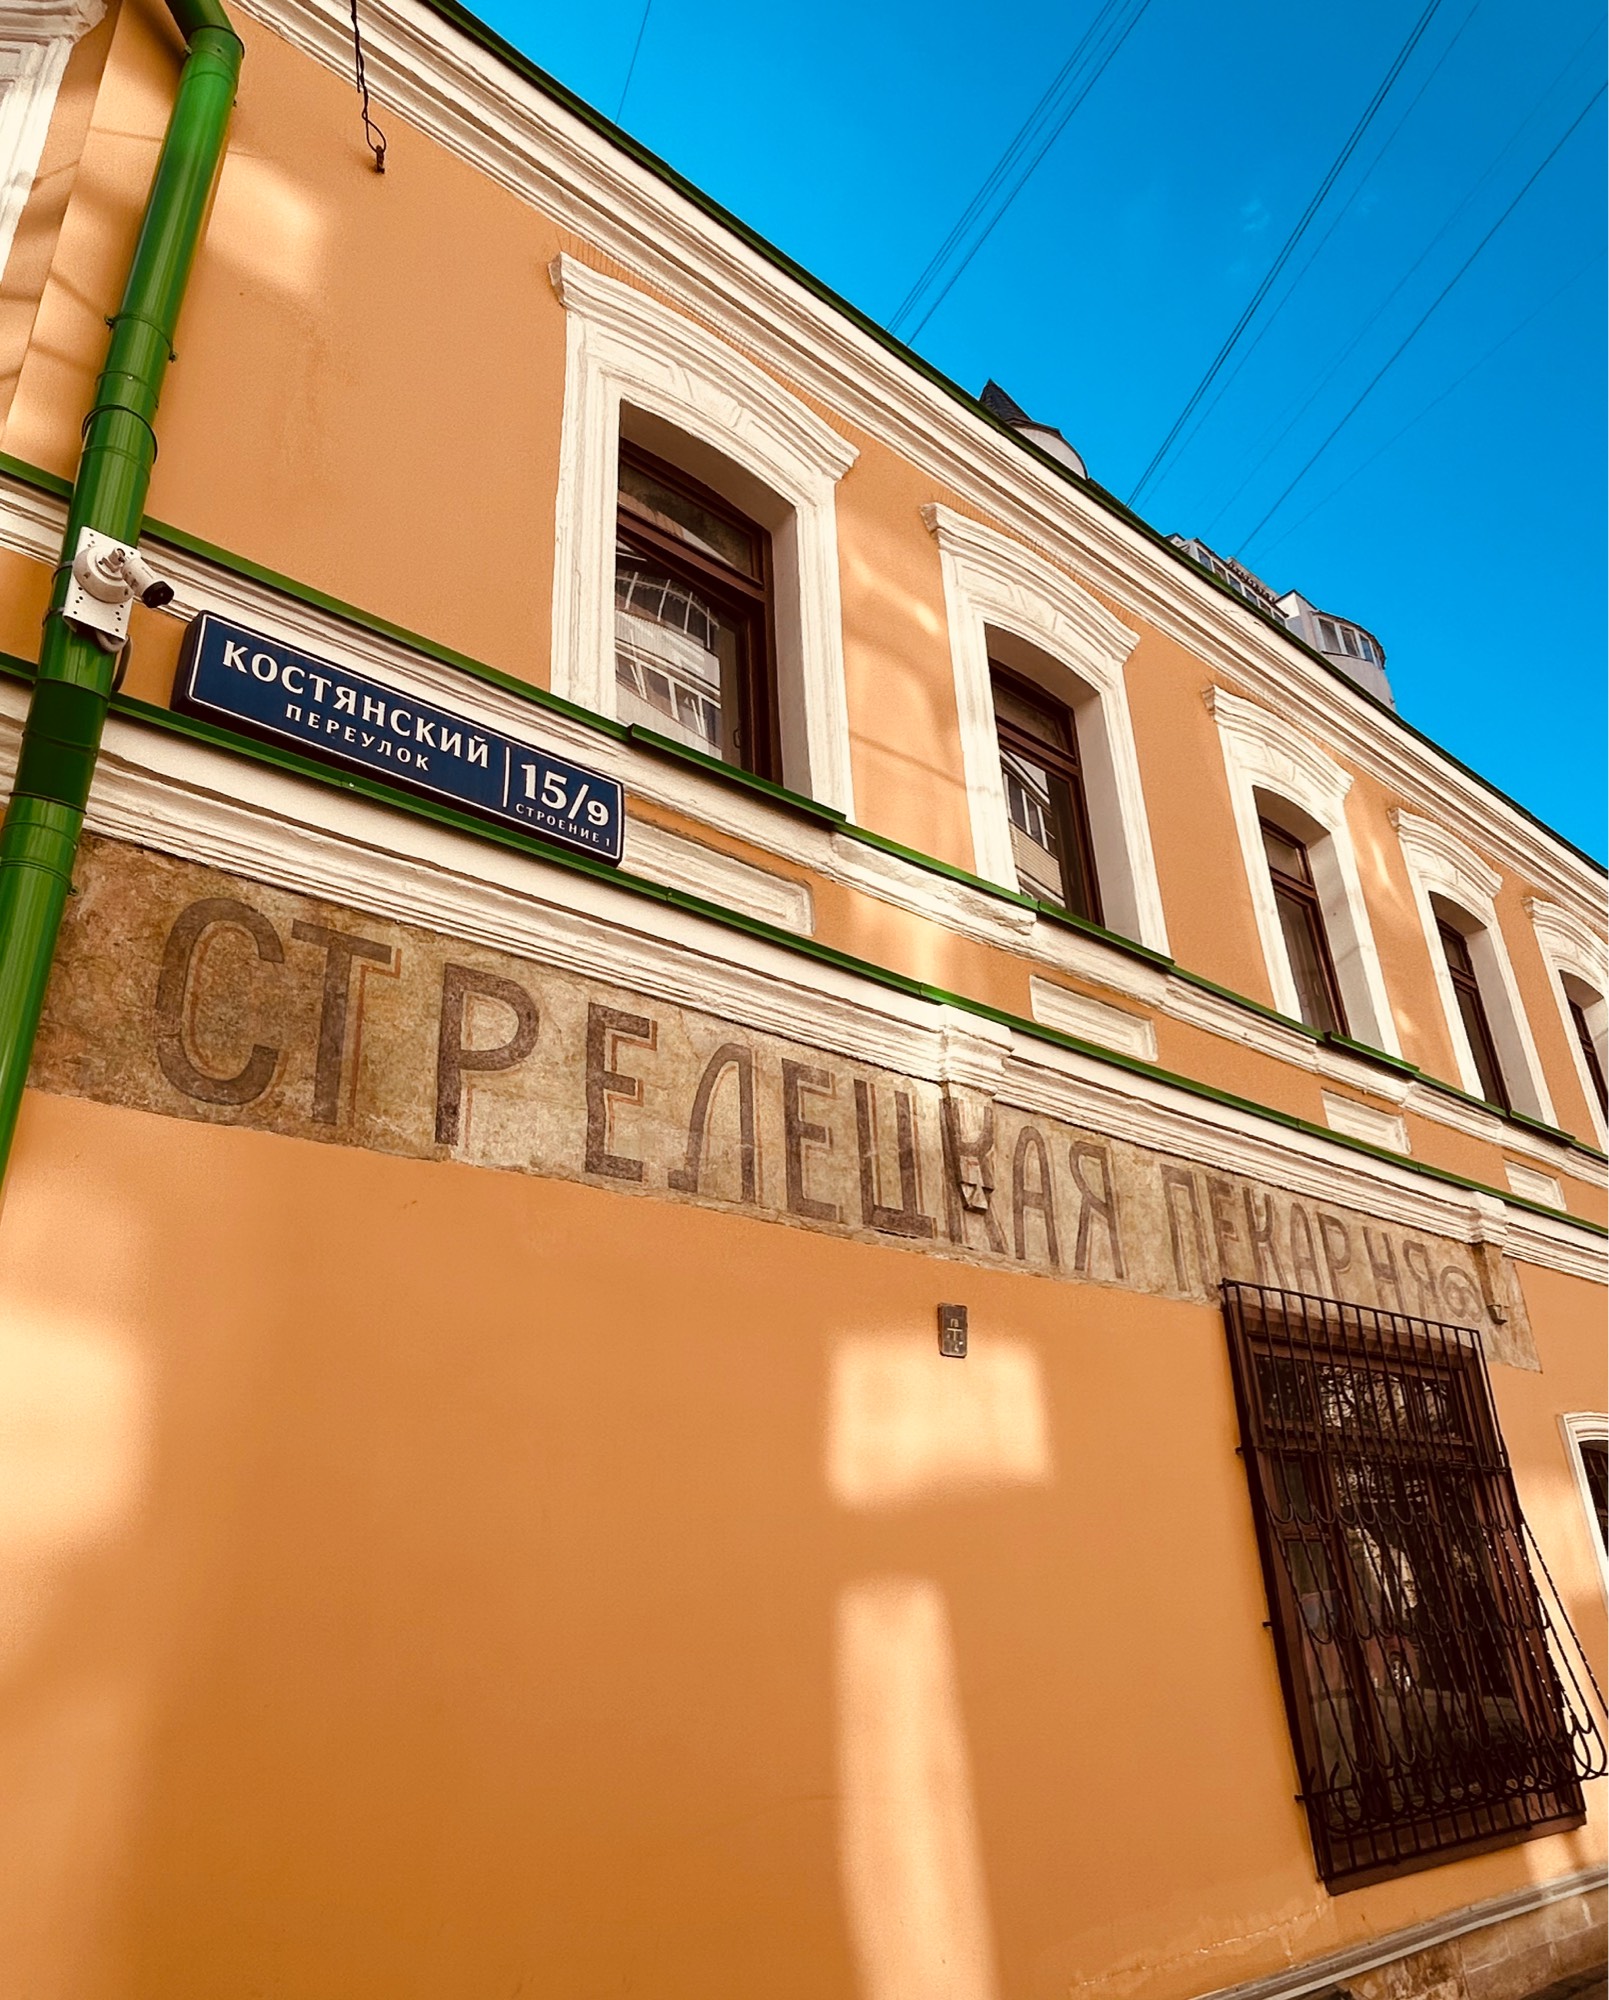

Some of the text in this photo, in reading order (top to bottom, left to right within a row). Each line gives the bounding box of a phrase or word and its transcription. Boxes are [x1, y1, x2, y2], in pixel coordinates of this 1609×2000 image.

[222, 640, 489, 769] КОСТЯНСКИЙ
[285, 703, 430, 772] ПЕРЕУЛОК
[516, 803, 610, 847] СТРОЕНИЕ 1
[521, 764, 609, 826] 15/9
[155, 897, 1442, 1322] СТРЕЛЕЦКАЯ ПЕКАРНЯ
